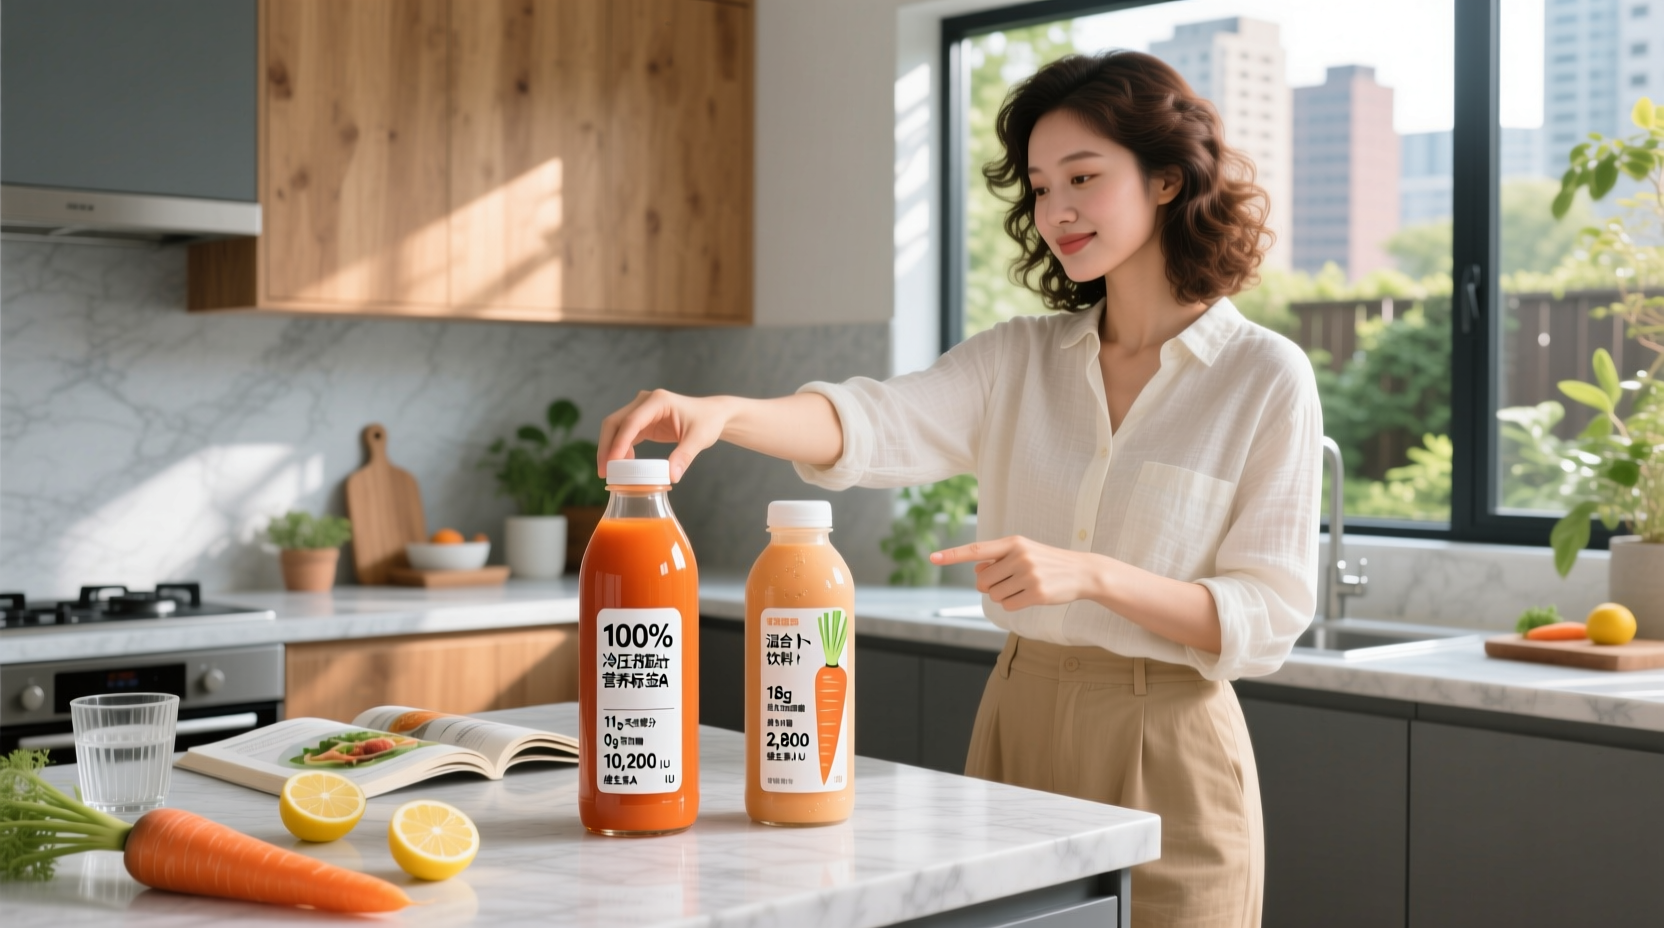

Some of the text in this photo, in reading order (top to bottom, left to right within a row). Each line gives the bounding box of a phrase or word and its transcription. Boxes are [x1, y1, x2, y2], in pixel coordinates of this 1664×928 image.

[603, 623, 673, 648] 100%
[604, 733, 619, 749] 0g
[603, 753, 671, 772] 10,200 IU
